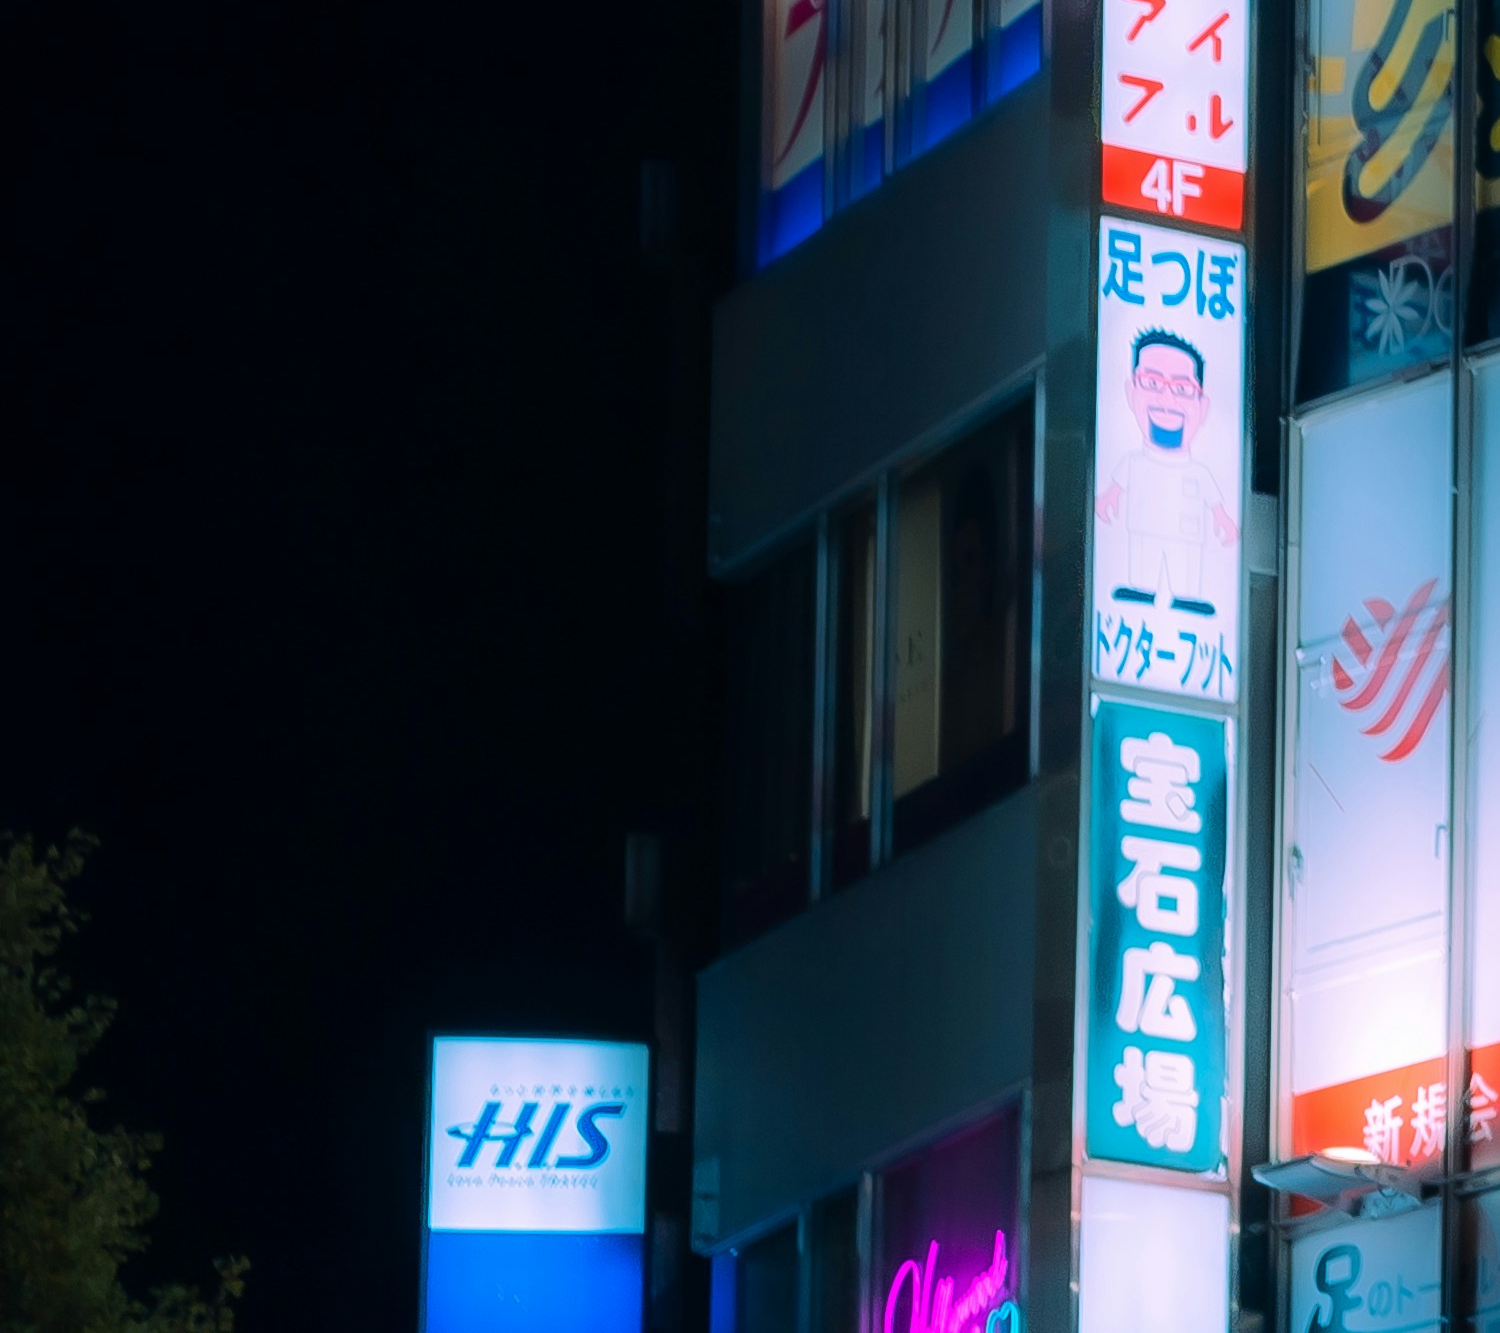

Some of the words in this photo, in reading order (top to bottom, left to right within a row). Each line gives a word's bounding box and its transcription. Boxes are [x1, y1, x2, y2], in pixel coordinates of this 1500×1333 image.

[1140, 158, 1204, 217] 4F
[1102, 229, 1237, 321] 足つぼ
[1096, 610, 1233, 697] ドクターフット
[1113, 732, 1202, 1153] 宝石広場
